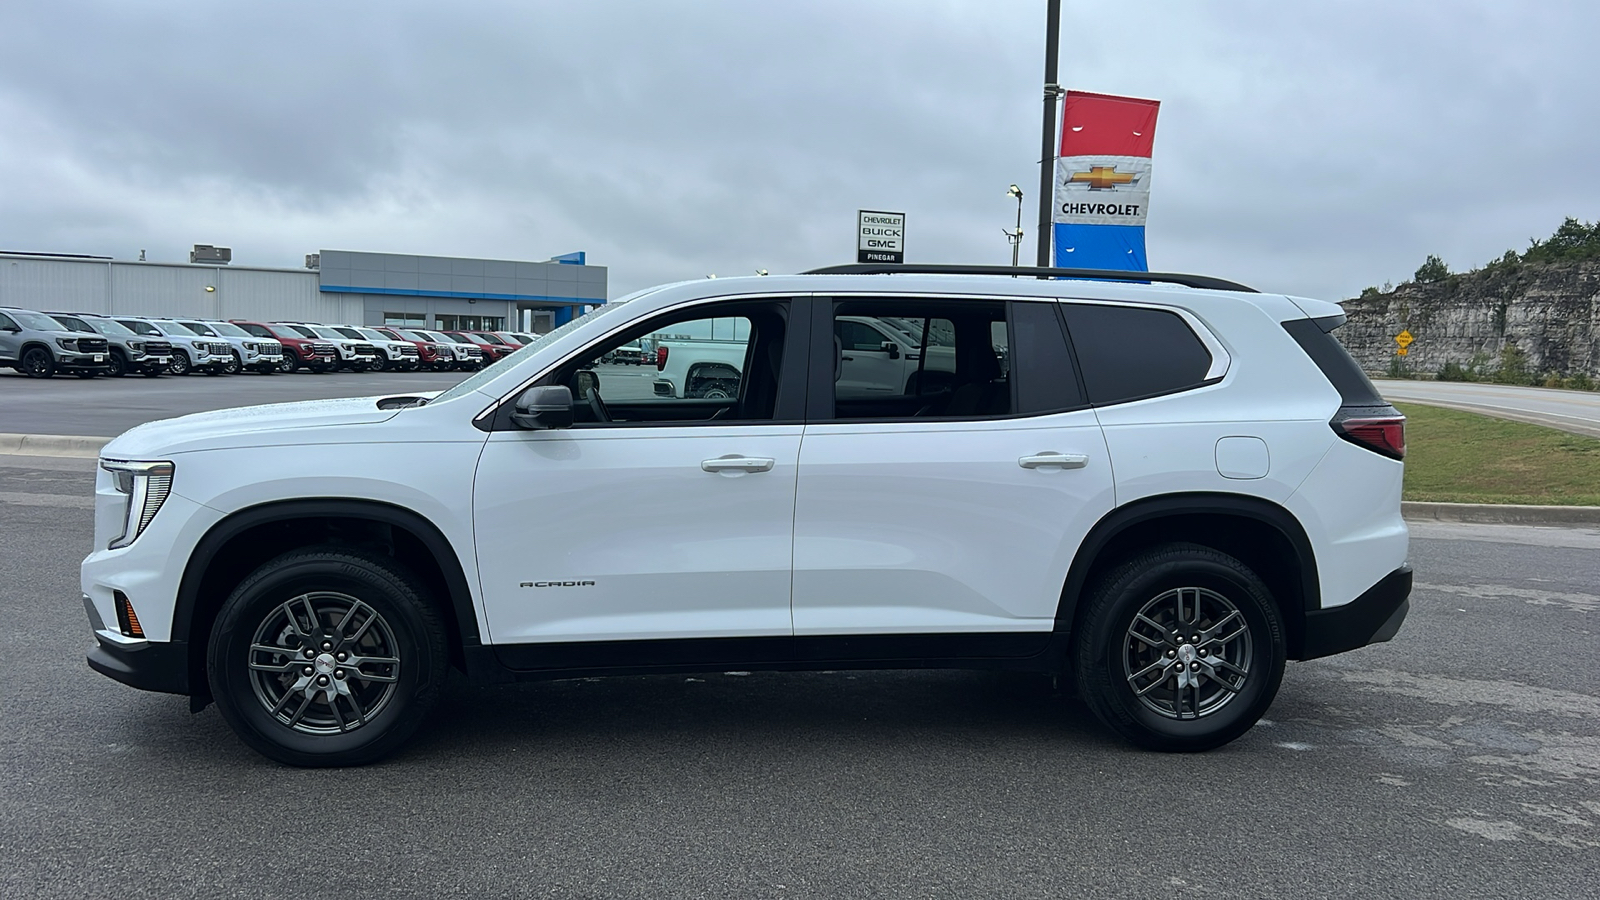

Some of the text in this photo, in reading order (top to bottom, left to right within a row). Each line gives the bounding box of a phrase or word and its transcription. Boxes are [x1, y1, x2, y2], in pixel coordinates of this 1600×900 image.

[864, 217, 901, 225] CHEVROLET
[863, 228, 901, 237] BUICK
[868, 240, 896, 249] GMC
[520, 580, 596, 588] ACADIA
